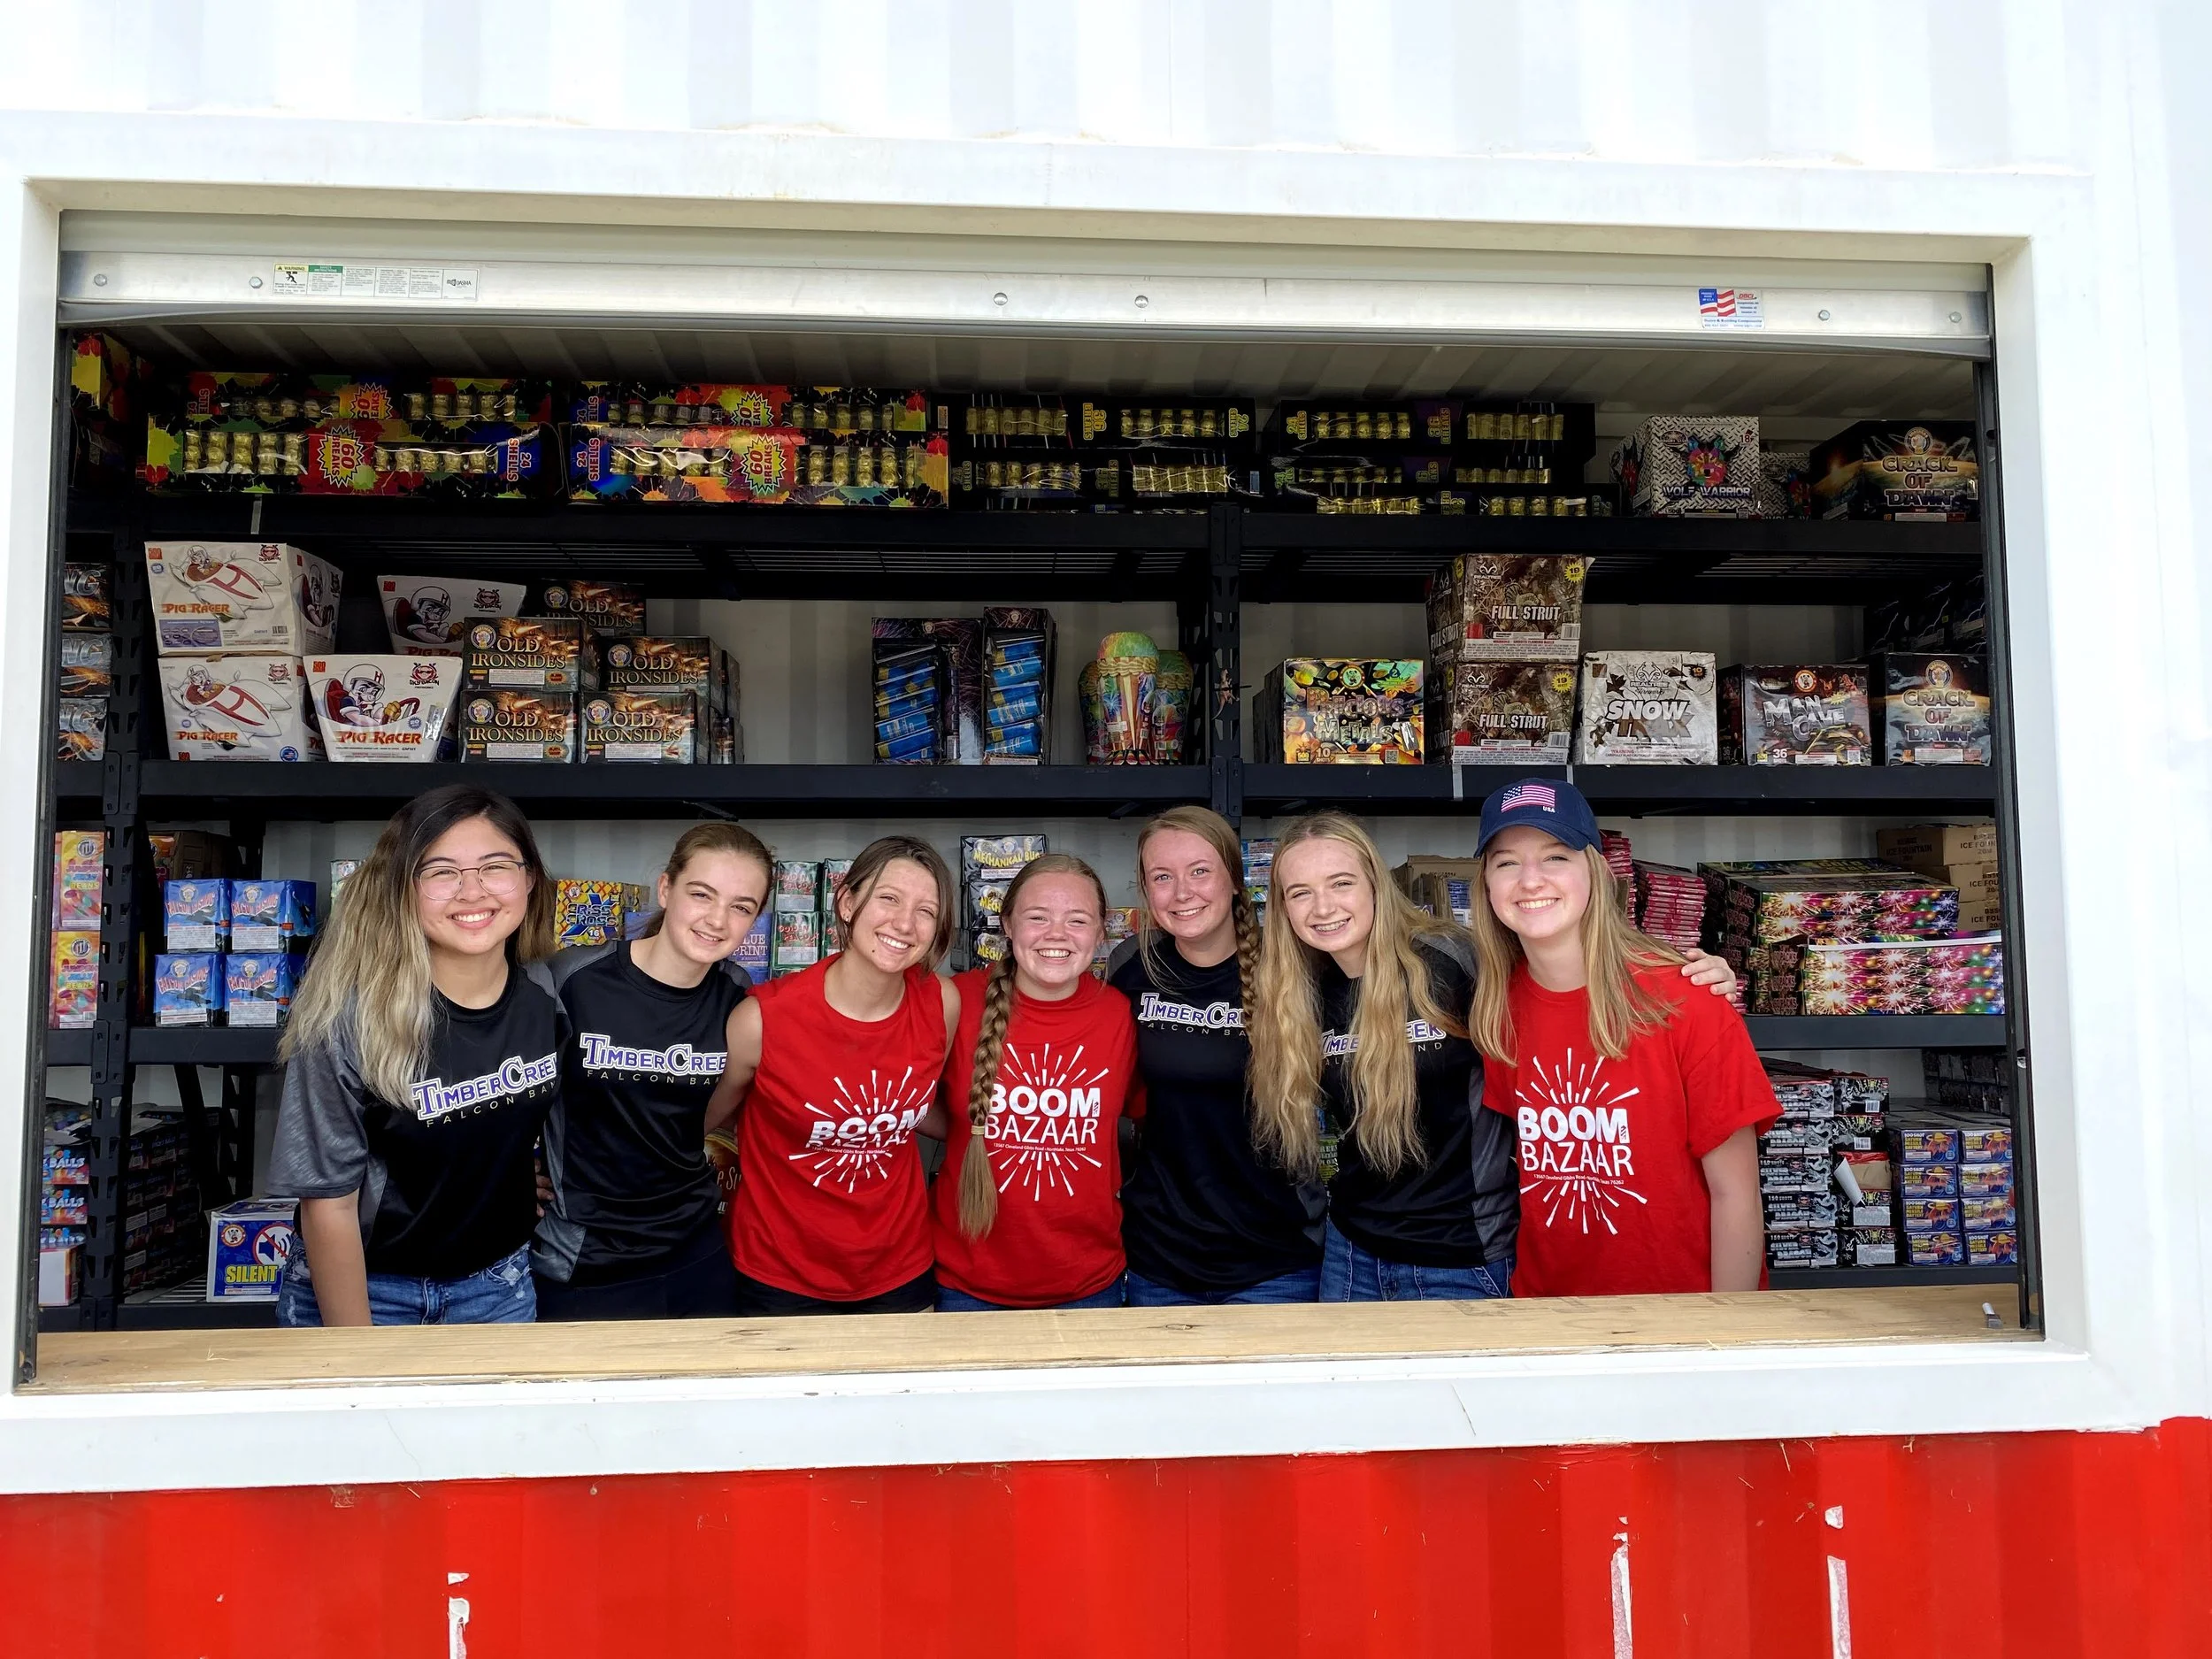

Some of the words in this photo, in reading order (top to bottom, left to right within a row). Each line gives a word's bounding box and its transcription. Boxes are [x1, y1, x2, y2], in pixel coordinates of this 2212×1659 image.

[199, 388, 210, 414] ELLS
[588, 396, 599, 422] ELLS
[1082, 403, 1094, 441] BREAKS
[1093, 410, 1107, 432] 36
[1228, 408, 1239, 438] SHELLS
[1237, 413, 1249, 432] 24
[1286, 417, 1298, 434] 24
[1297, 410, 1307, 440] SHELLS
[1440, 407, 1451, 444] BREAKS
[341, 443, 355, 469] 60
[507, 438, 519, 481] SHELLS
[520, 452, 532, 468] 24
[577, 451, 588, 467] 24
[588, 437, 601, 481] SHELLS
[749, 450, 763, 474] 60
[764, 444, 772, 484] BREAKS
[1882, 455, 1958, 472] CRACK
[962, 460, 972, 491] SHELLS
[1904, 472, 1933, 489] OF
[1662, 486, 1695, 497] WOLF
[1700, 486, 1752, 497] WARRIOR
[1885, 488, 1955, 507] DAWN
[165, 603, 187, 613] PIG
[190, 603, 230, 614] RACER
[569, 599, 609, 613] OLD
[1491, 605, 1519, 620] FULL
[1522, 605, 1561, 621] STRUT
[1442, 621, 1459, 645] STRUT
[497, 637, 540, 652] OLD
[472, 653, 565, 668] IRONSIDES
[634, 656, 674, 671] OLD
[610, 671, 698, 685] IRONSIDES
[1903, 689, 1976, 707] CRACK
[495, 711, 538, 726] OLD
[612, 712, 656, 727] OLD
[1605, 699, 1690, 722] SNOW
[1763, 695, 1823, 726] MAN
[1924, 708, 1952, 724] OF
[1479, 713, 1506, 728] FULL
[1509, 714, 1548, 729] STRUT
[1793, 708, 1846, 741] CAVE
[178, 731, 198, 741] PIG
[203, 731, 238, 741] RACER
[338, 731, 367, 744] PIG
[372, 731, 422, 744] RACER
[469, 727, 565, 742] IRONSIDES
[588, 728, 683, 742] IRONSIDES
[1315, 718, 1395, 745] METALS
[1905, 724, 1973, 743] DAWN
[1317, 748, 1331, 757] 10
[1773, 749, 1787, 758] 36
[973, 849, 1023, 868] MECHANICAL
[566, 902, 611, 916] CRISS
[566, 913, 618, 927] CROSS
[743, 934, 765, 945] LUE
[733, 945, 768, 956] PRINT
[1138, 992, 1247, 1029] TIMBERCR
[1141, 1021, 1210, 1034] ALCON
[580, 1033, 728, 1076] TIMBERCREE
[411, 1051, 557, 1120] TIMBERCREE
[588, 1070, 674, 1084] FALCON
[990, 1083, 1101, 1118] BOOM
[426, 1095, 514, 1127] FALCON
[810, 1102, 929, 1141] BOOM
[984, 1114, 1098, 1145] BAZAAR
[1517, 1106, 1631, 1144] BOOM
[49, 1156, 85, 1169] BALLS
[1520, 1141, 1635, 1177] BAZAAR
[46, 1196, 84, 1209] BALLS
[225, 1264, 279, 1284] SILENT
